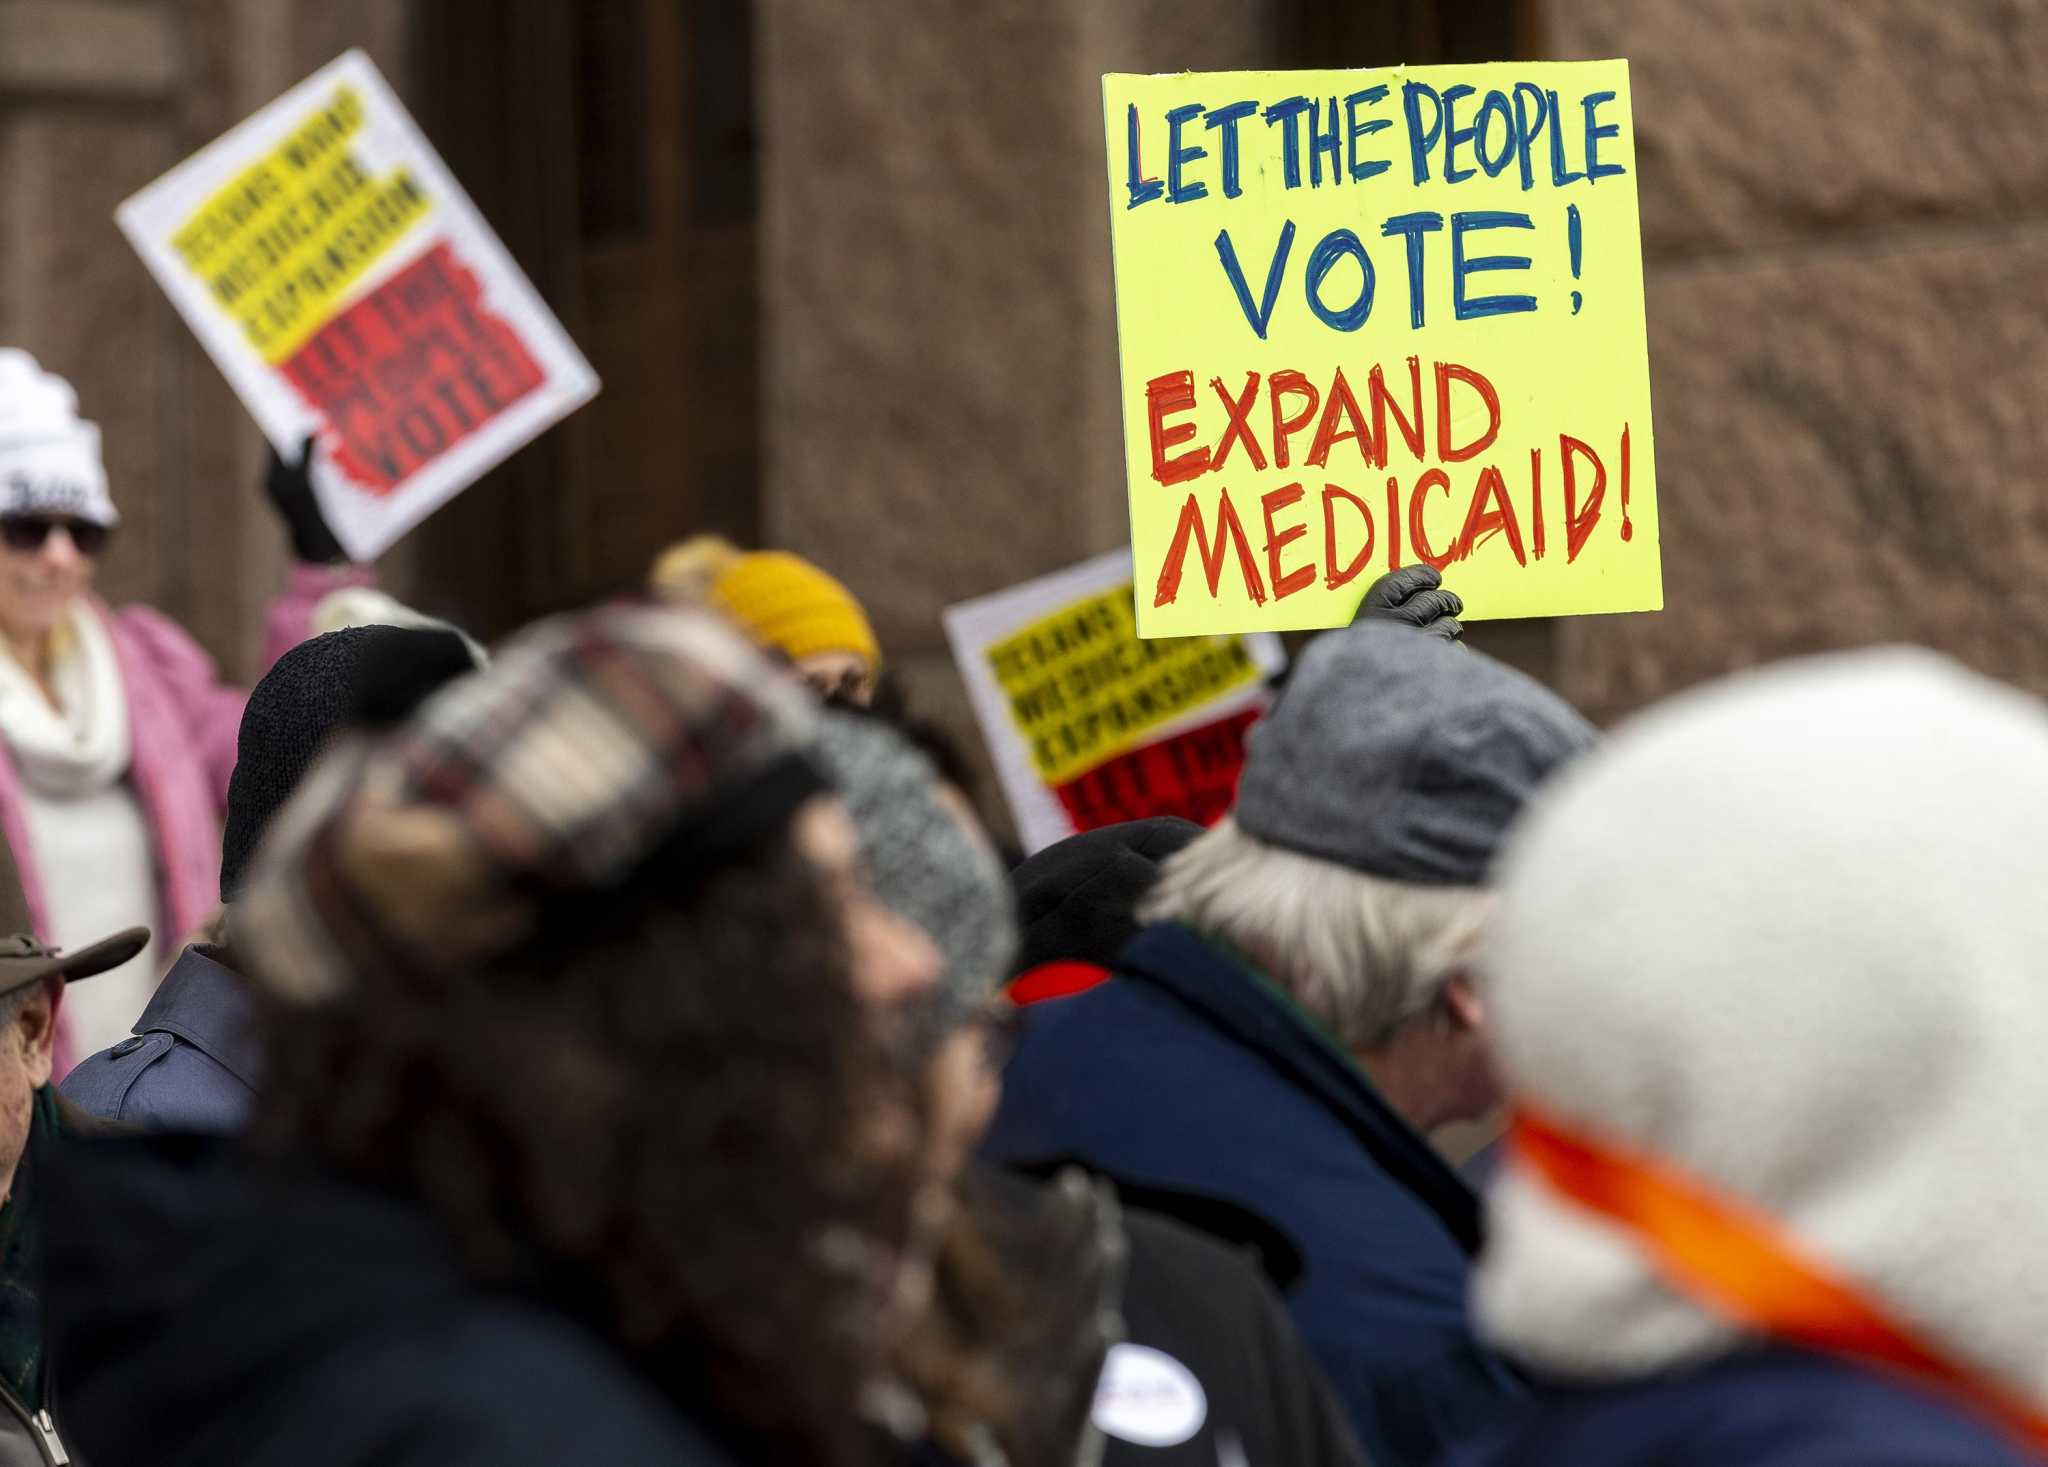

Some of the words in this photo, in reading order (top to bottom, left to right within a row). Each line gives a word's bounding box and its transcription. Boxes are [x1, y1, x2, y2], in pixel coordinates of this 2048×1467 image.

[1127, 100, 1259, 209] LET
[1261, 83, 1393, 188] THE
[1402, 80, 1626, 191] PEOPLE
[1146, 354, 1502, 487] EXPAND
[1153, 421, 1634, 609] MEDICAID!
